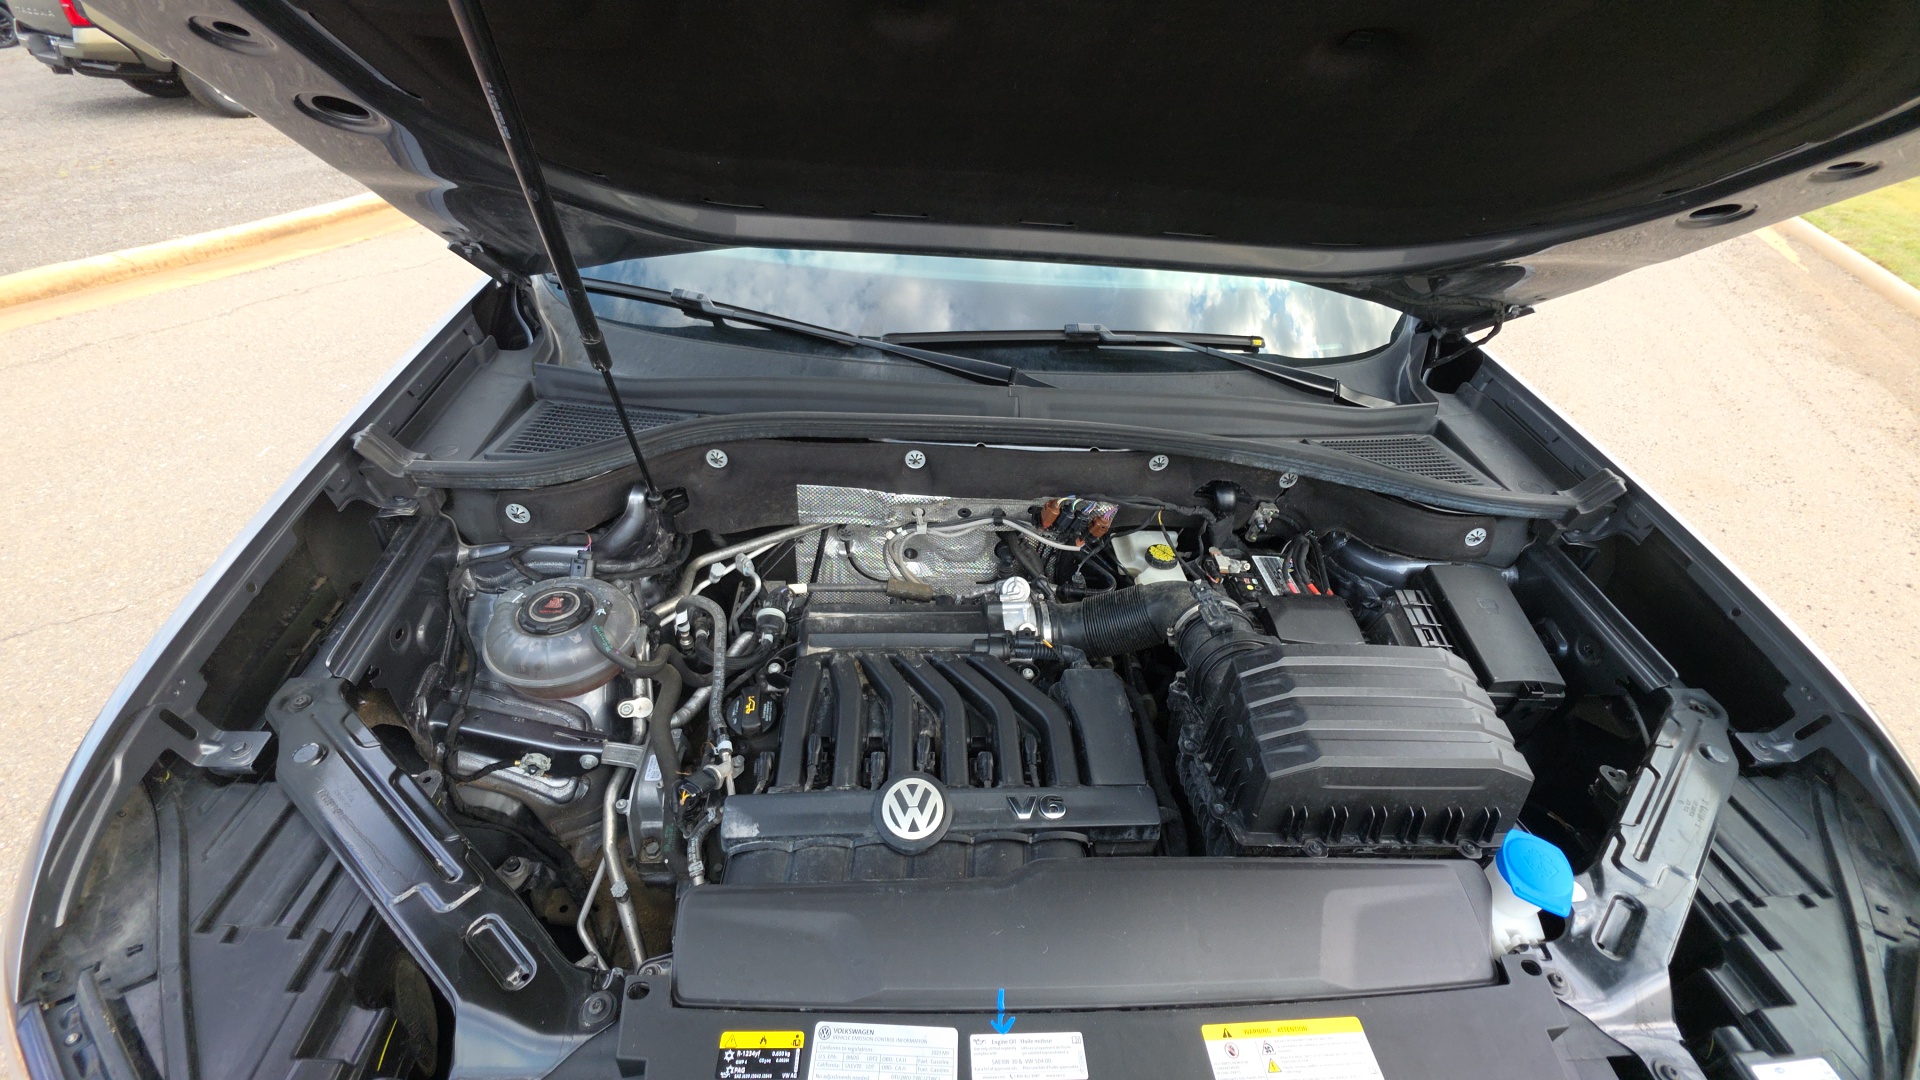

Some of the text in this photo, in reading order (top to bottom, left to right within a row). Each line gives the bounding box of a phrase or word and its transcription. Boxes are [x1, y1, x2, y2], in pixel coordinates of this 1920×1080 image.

[881, 777, 945, 840] VW
[1006, 794, 1067, 820] V6
[833, 1027, 875, 1035] VOLKSWAGEN
